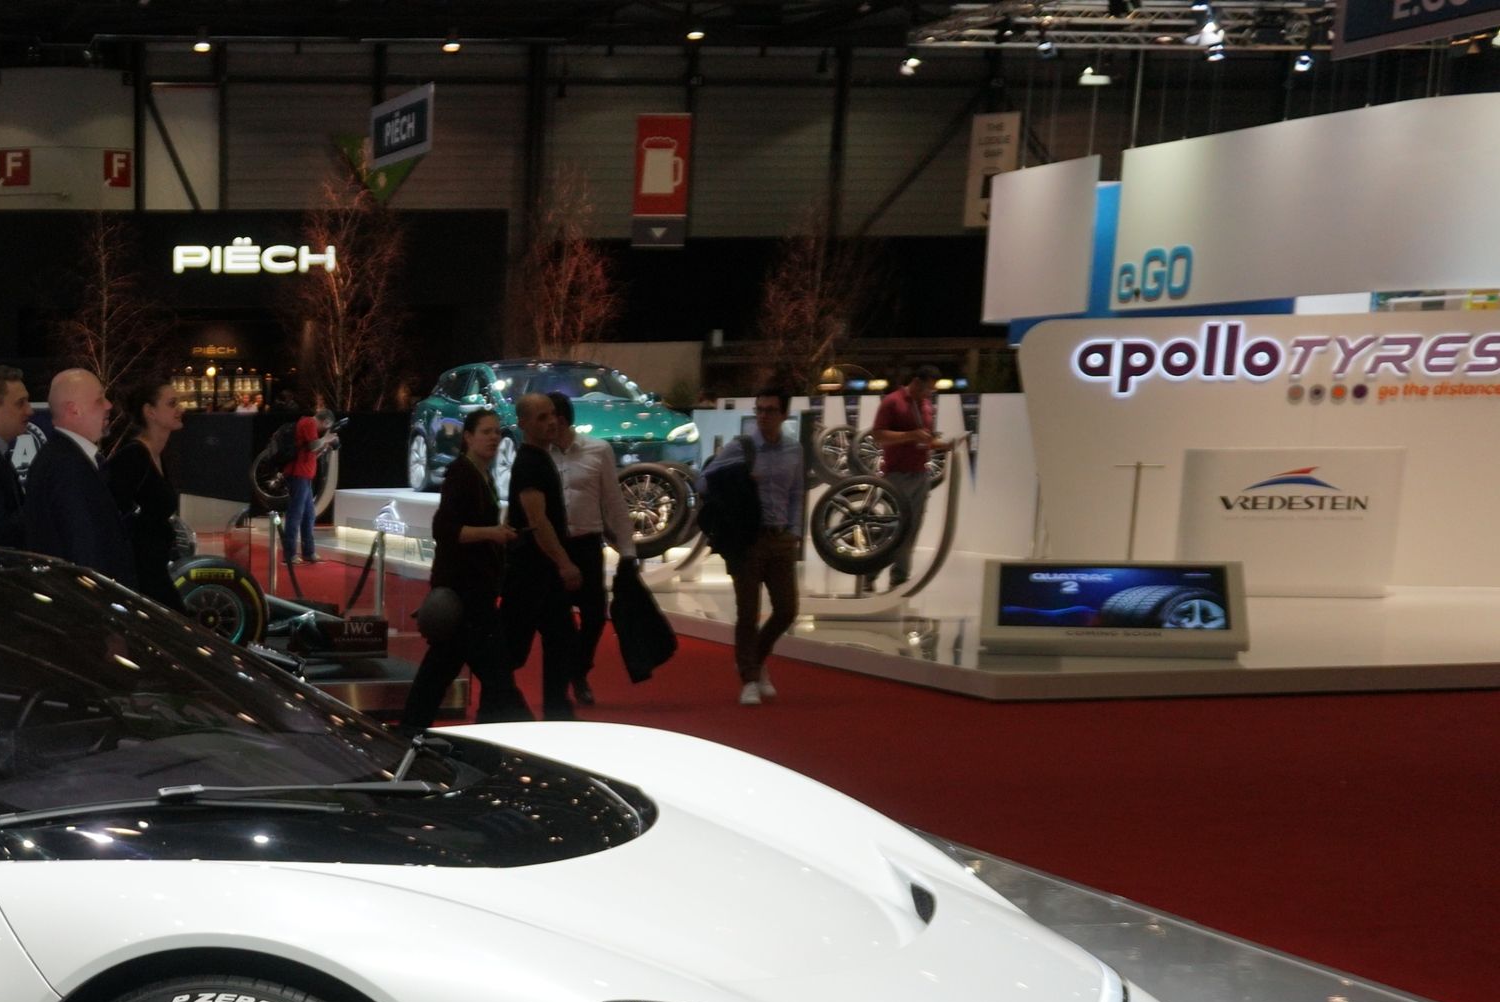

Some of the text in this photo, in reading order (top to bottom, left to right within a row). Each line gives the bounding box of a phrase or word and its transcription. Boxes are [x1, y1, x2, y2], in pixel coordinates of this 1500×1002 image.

[385, 111, 415, 146] PIËCH
[6, 153, 23, 177] F
[113, 153, 126, 178] F
[173, 237, 336, 274] PIËCH
[1116, 245, 1193, 303] e.GO
[1076, 322, 1500, 395] apollo TYRES
[1403, 383, 1428, 396] the
[1220, 495, 1369, 511] VREDESTEIN
[344, 622, 373, 634] IWC
